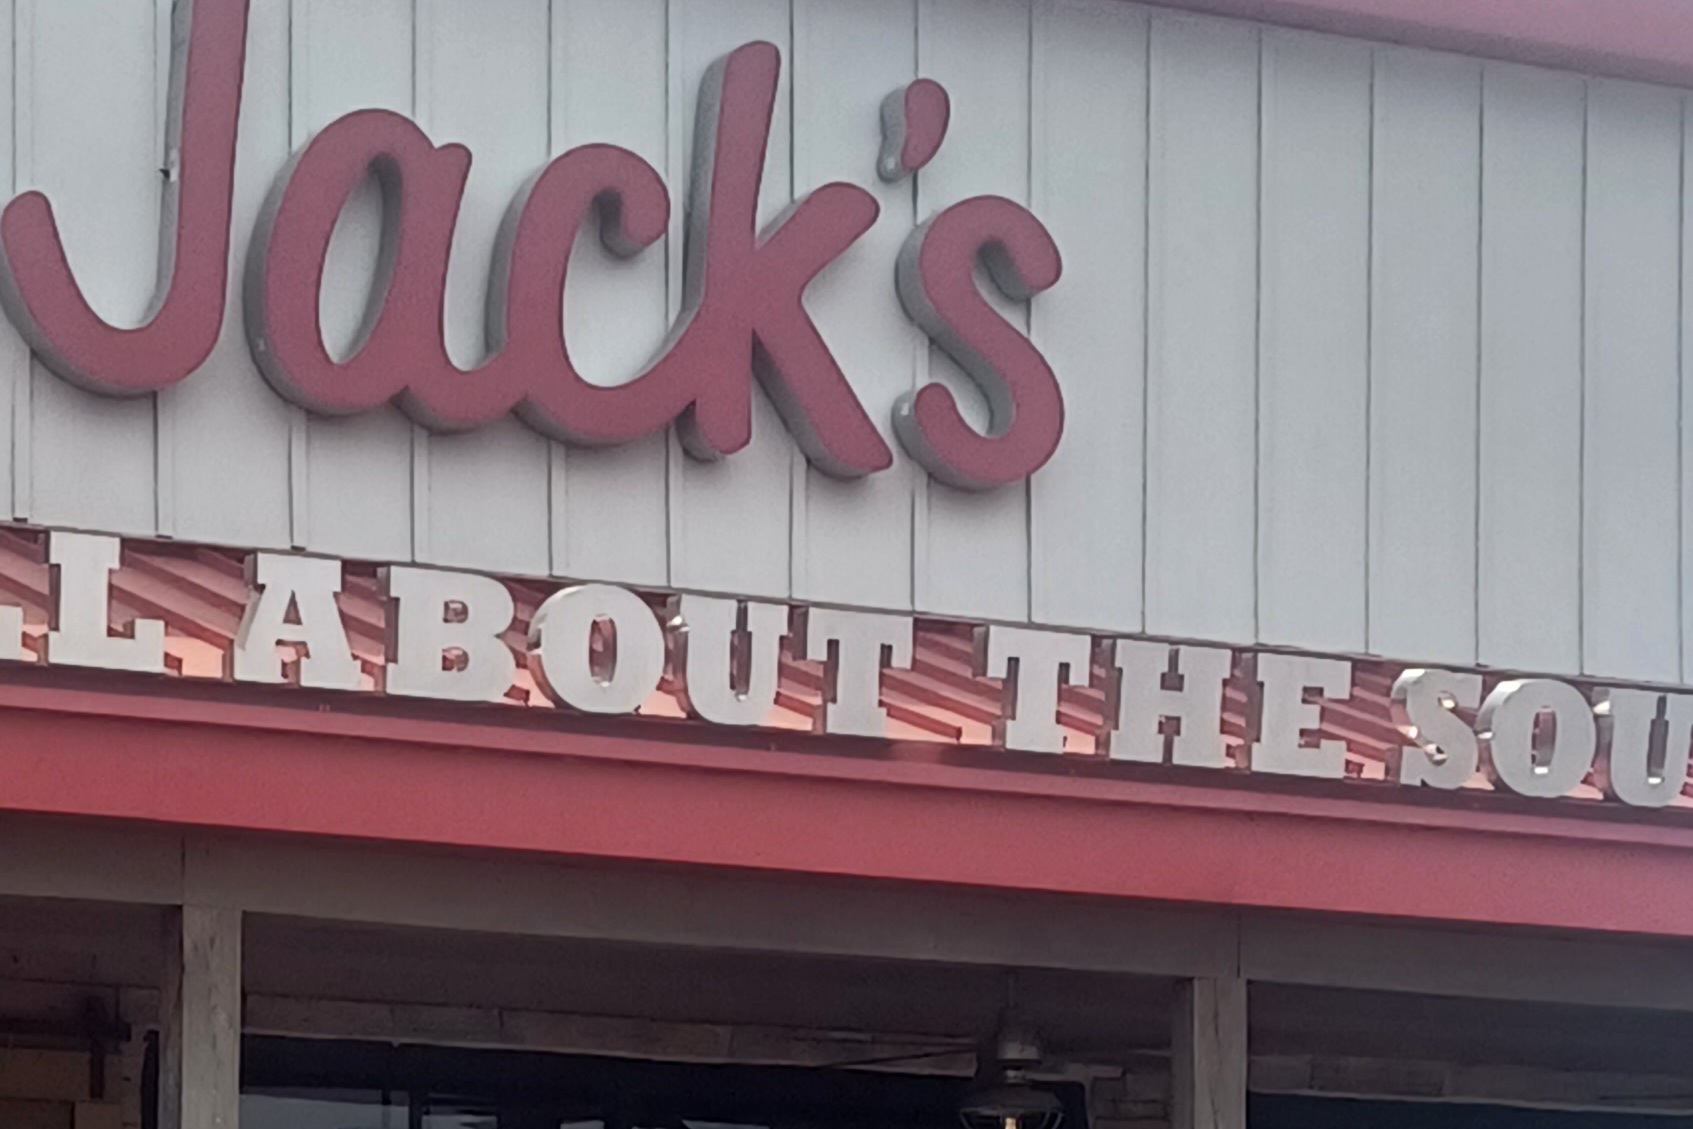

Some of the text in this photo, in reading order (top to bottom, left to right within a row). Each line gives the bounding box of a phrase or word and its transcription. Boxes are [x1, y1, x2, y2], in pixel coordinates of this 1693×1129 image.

[0, 0, 1065, 491] Jack's
[235, 552, 913, 739] ABOUT
[986, 623, 1353, 780] THE
[1392, 667, 1693, 808] SOU
